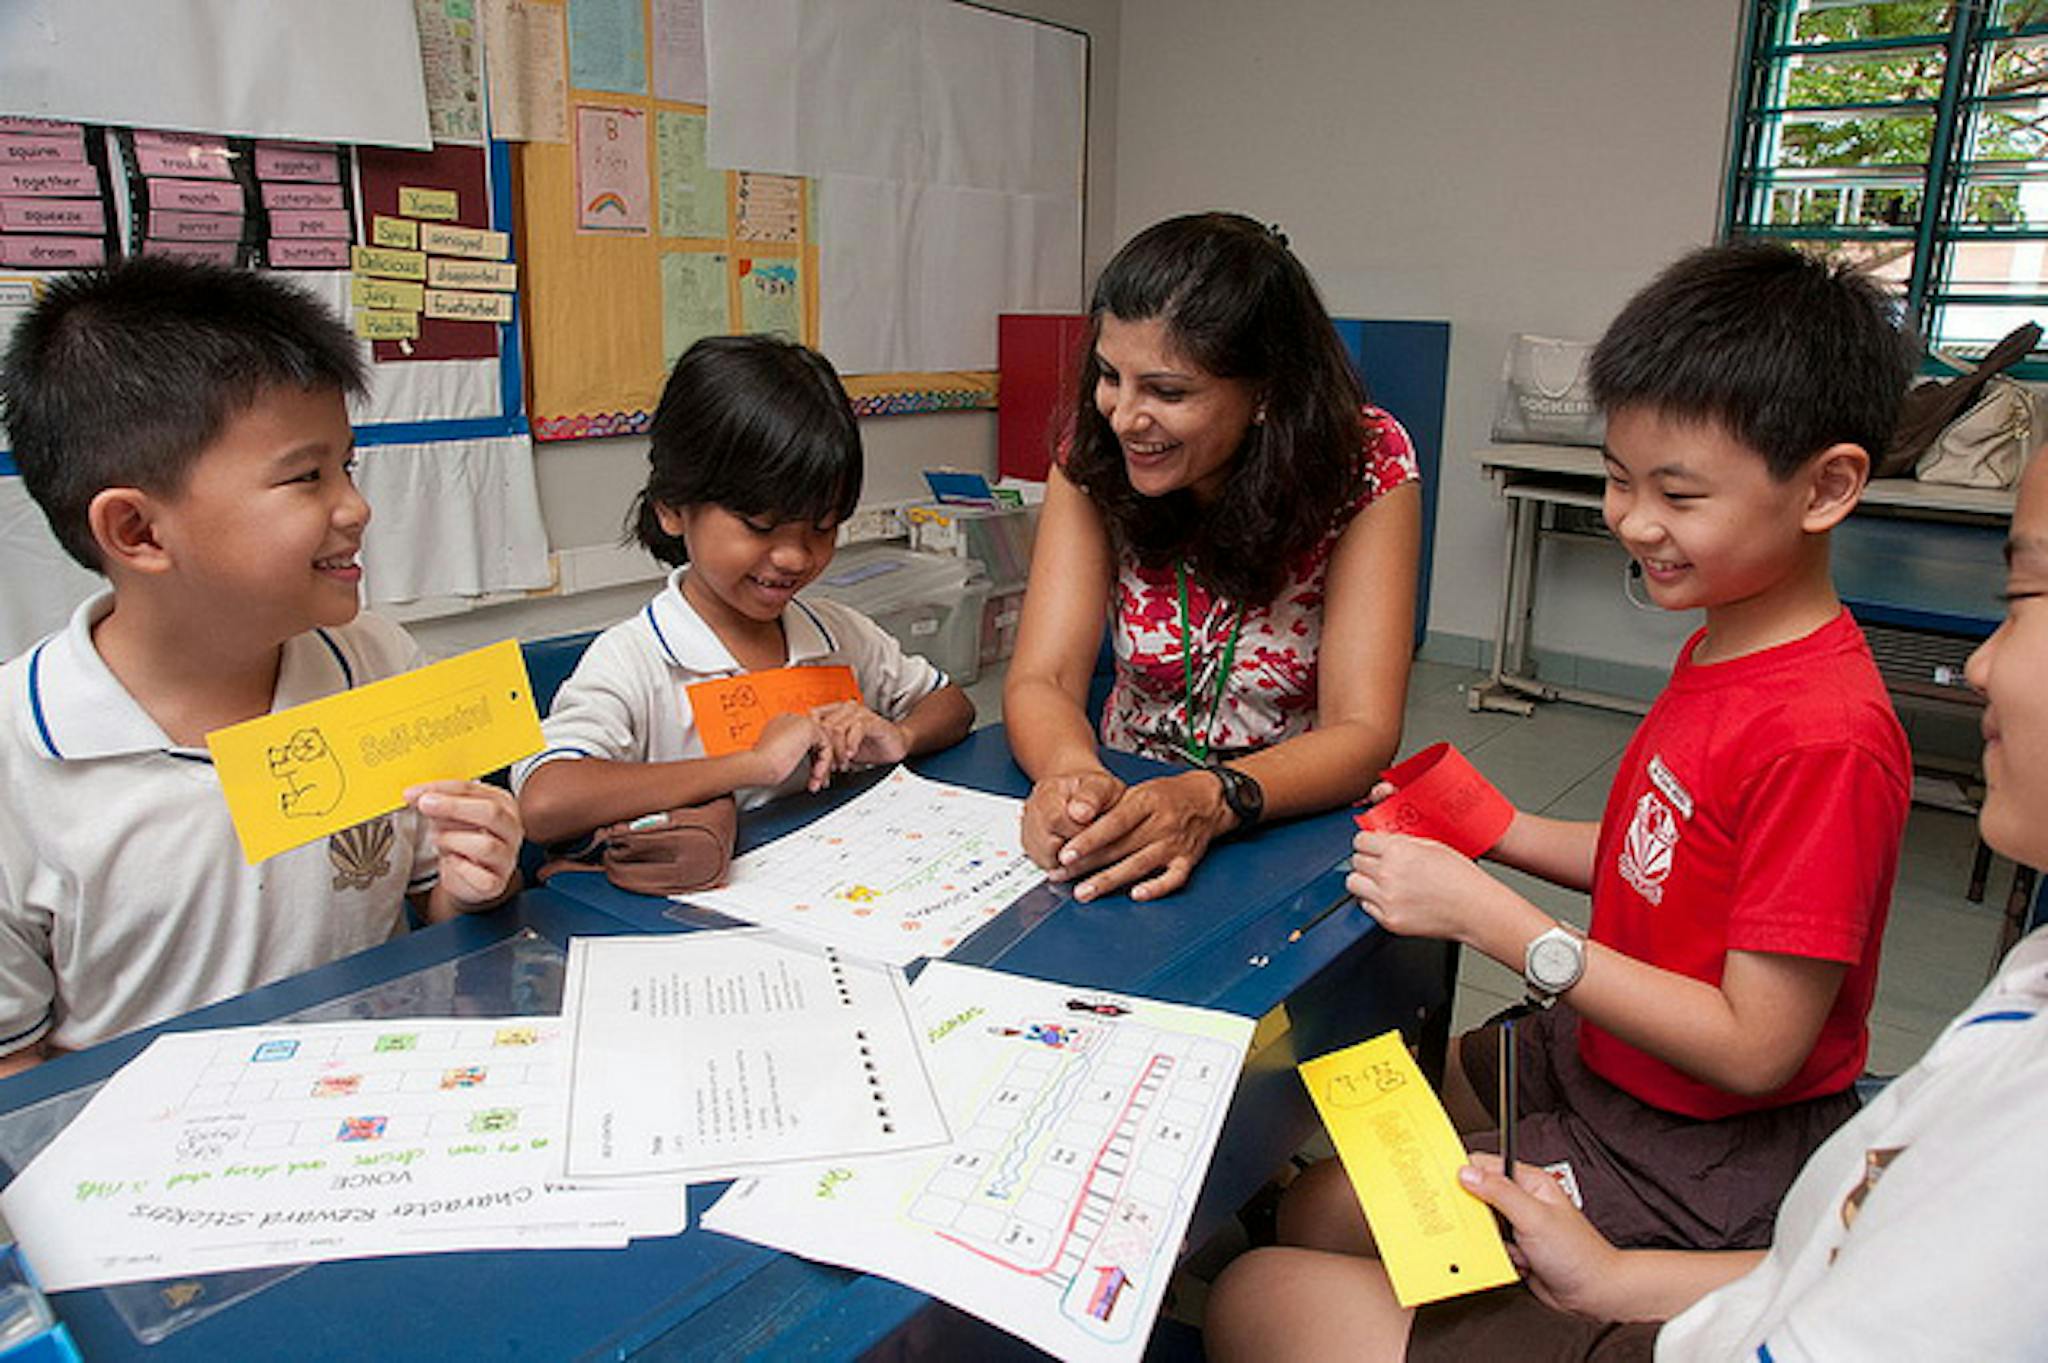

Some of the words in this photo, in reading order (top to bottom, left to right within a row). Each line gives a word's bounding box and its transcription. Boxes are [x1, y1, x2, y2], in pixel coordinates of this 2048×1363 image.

[13, 175, 81, 191] together
[178, 190, 221, 204] mouth
[407, 192, 455, 215] Yummy
[25, 210, 81, 225] squeeze
[29, 246, 77, 259] dream
[282, 246, 337, 261] butterfly
[358, 250, 419, 274] Delicious
